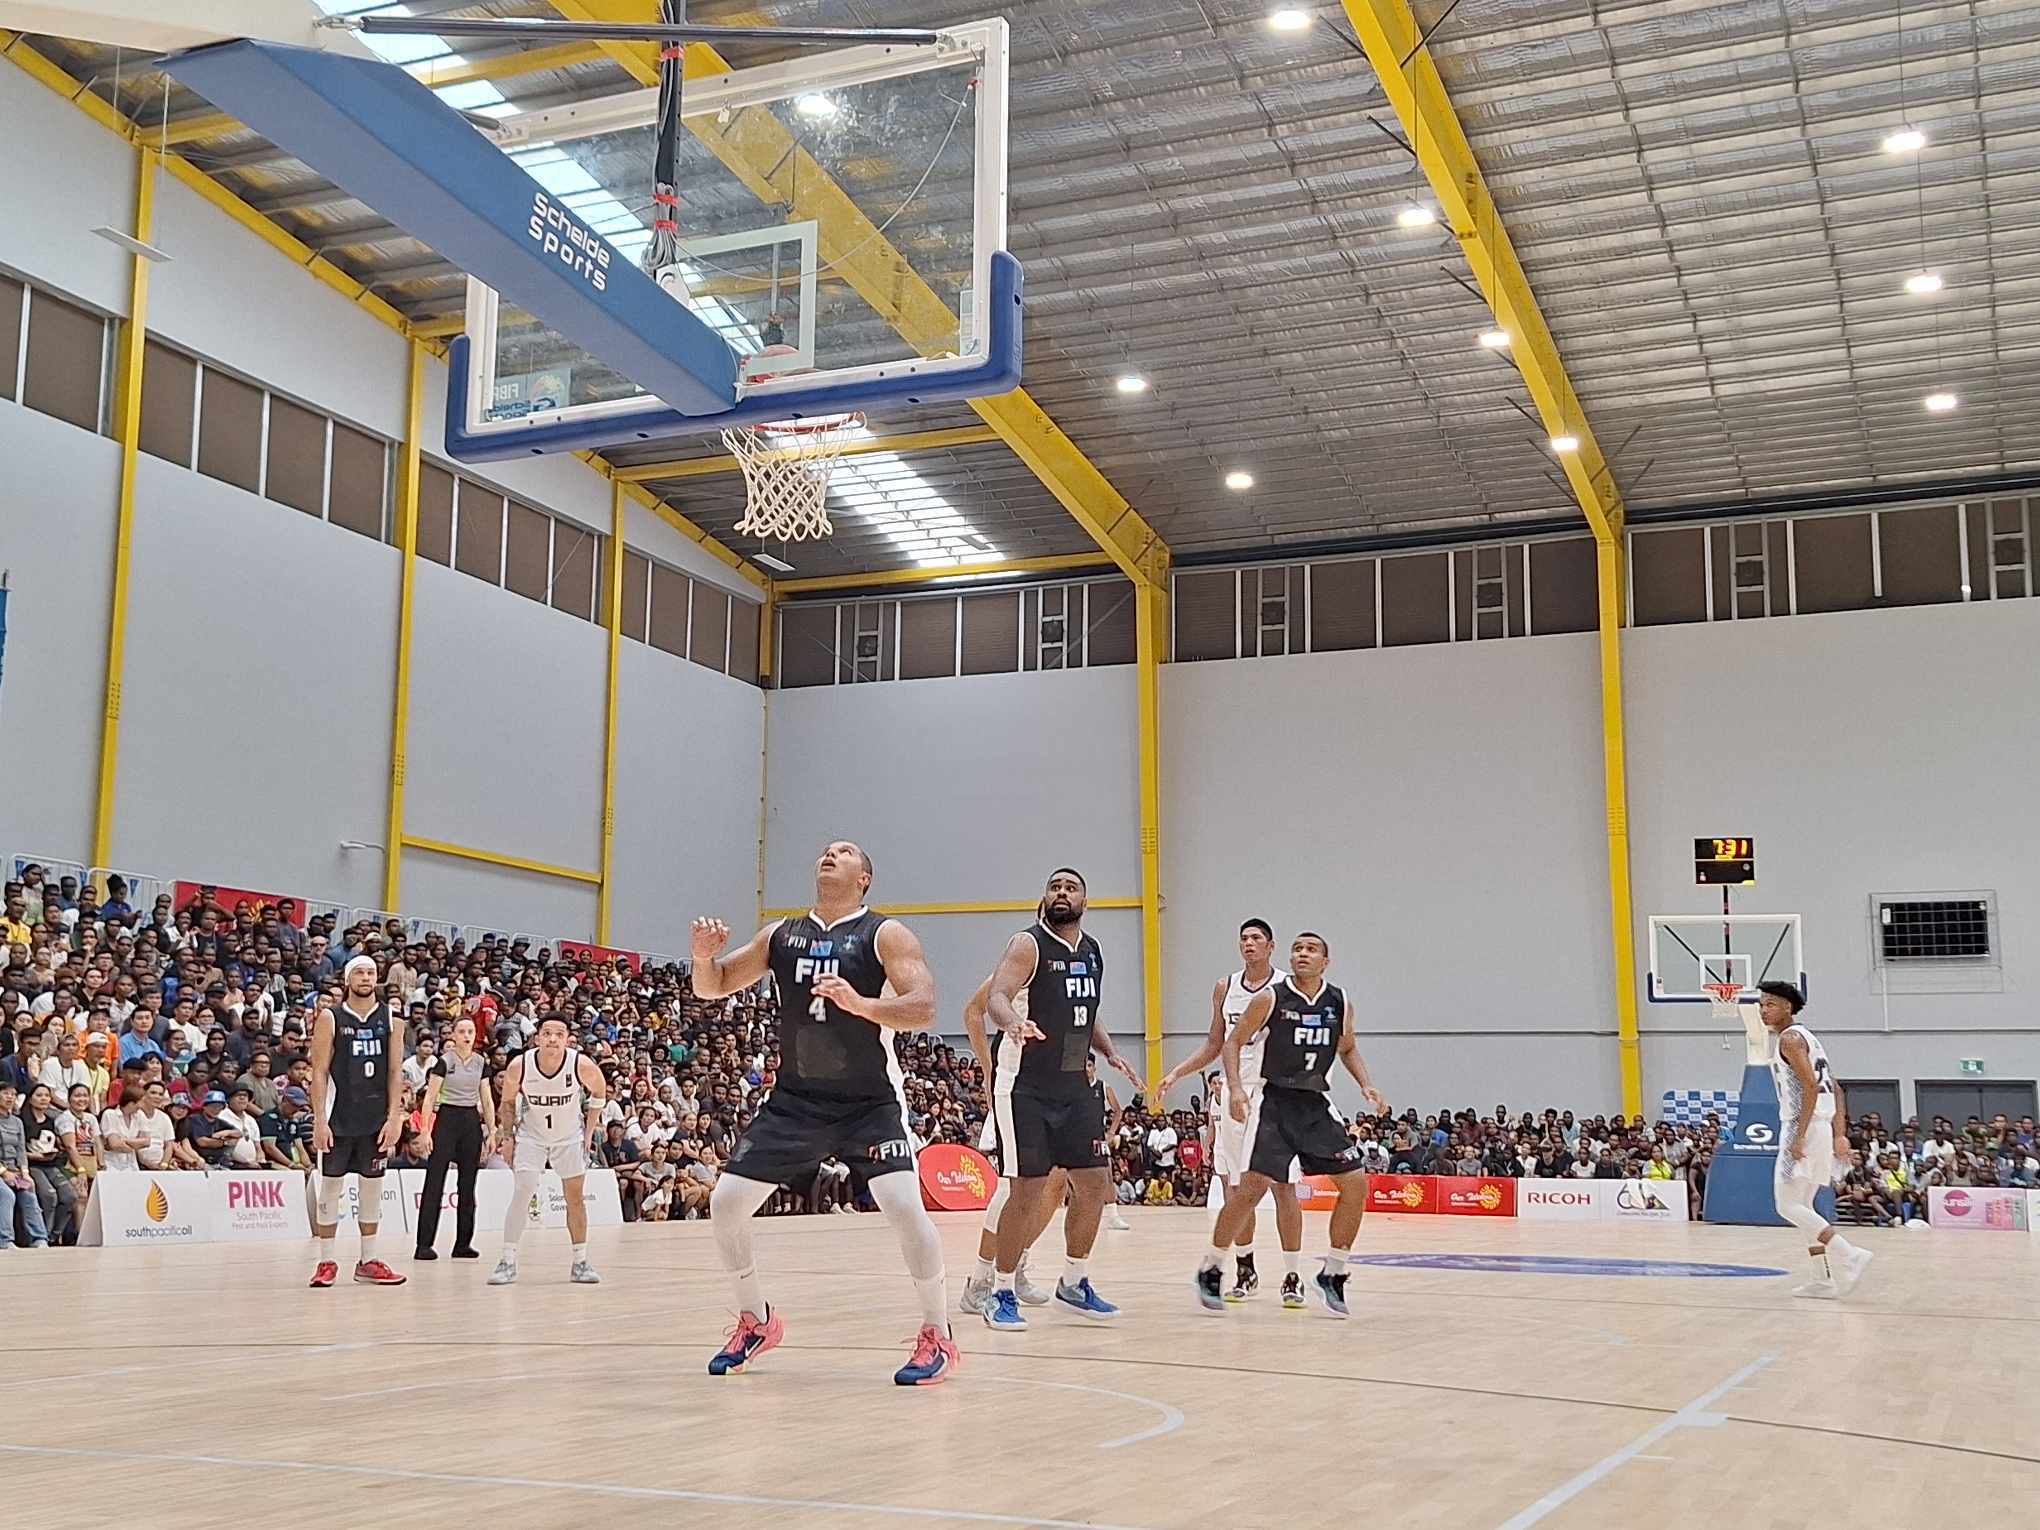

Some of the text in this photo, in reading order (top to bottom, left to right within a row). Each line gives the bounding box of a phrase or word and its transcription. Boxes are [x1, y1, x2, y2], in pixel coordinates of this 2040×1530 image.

[533, 192, 610, 269] Schelde
[528, 215, 607, 292] Sports
[1065, 977, 1097, 998] FIJI
[808, 996, 827, 1022] 4
[1073, 1005, 1088, 1027] 13
[1294, 1027, 1331, 1046] FIJI
[352, 1039, 382, 1056] FIJI
[364, 1061, 375, 1077] 0
[1304, 1052, 1318, 1071] 7
[545, 1114, 553, 1129] 1
[228, 1181, 286, 1208] PINK
[1527, 1192, 1591, 1205] RICOH
[125, 1225, 193, 1238] southpacificoil
